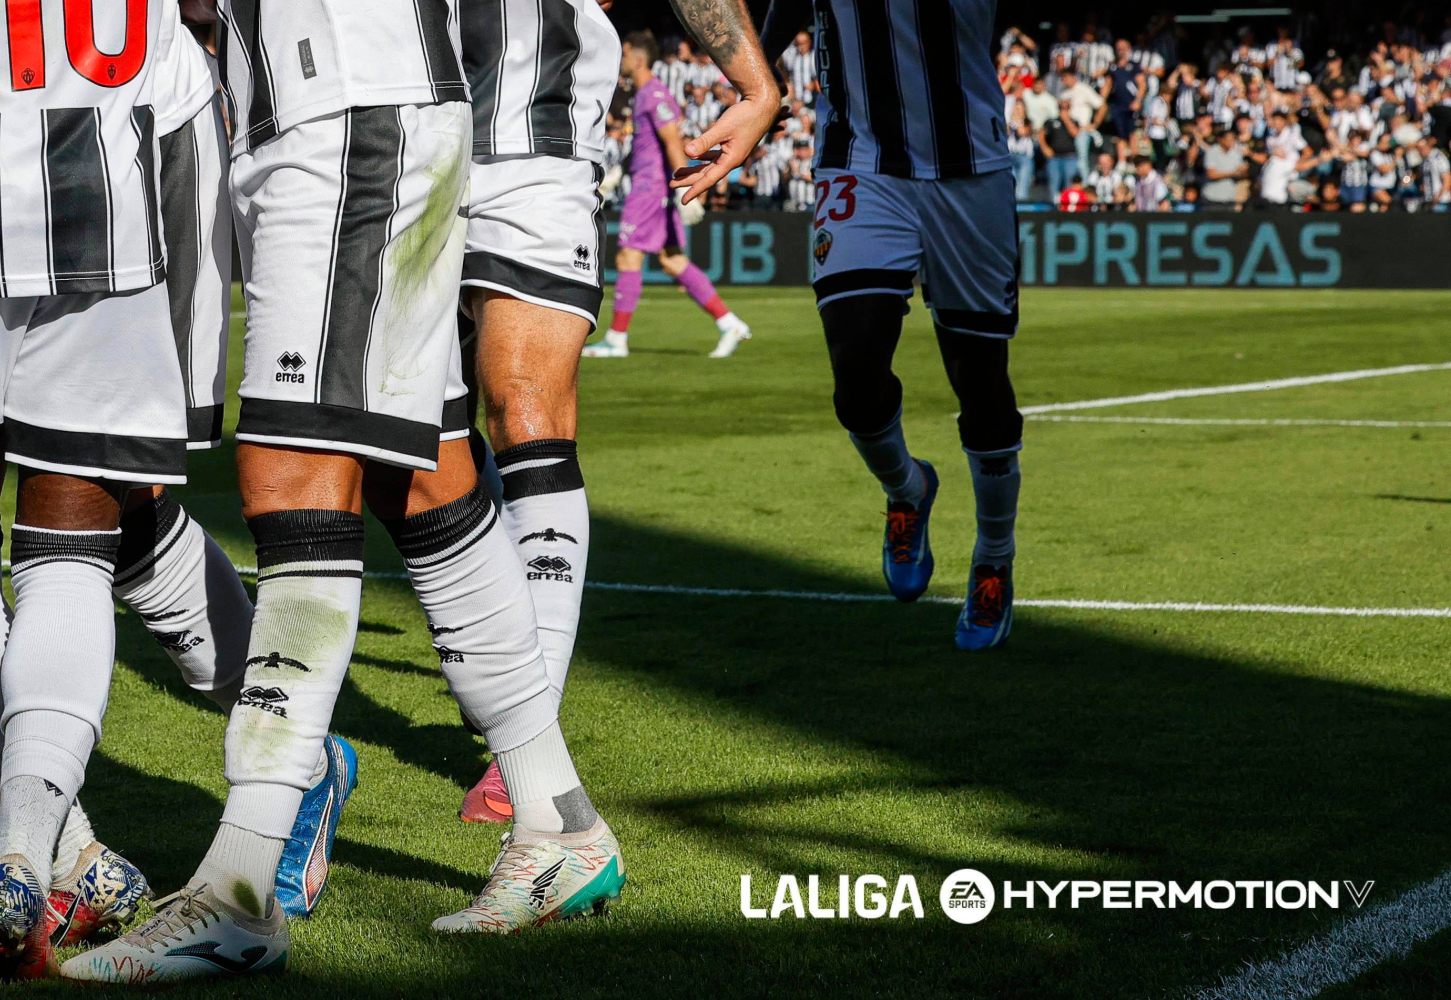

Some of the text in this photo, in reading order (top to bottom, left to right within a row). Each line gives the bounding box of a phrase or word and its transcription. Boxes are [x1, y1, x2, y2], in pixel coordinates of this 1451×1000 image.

[814, 174, 858, 231] 23
[573, 259, 591, 271] errea
[275, 371, 305, 384] errea
[526, 571, 574, 584] errea
